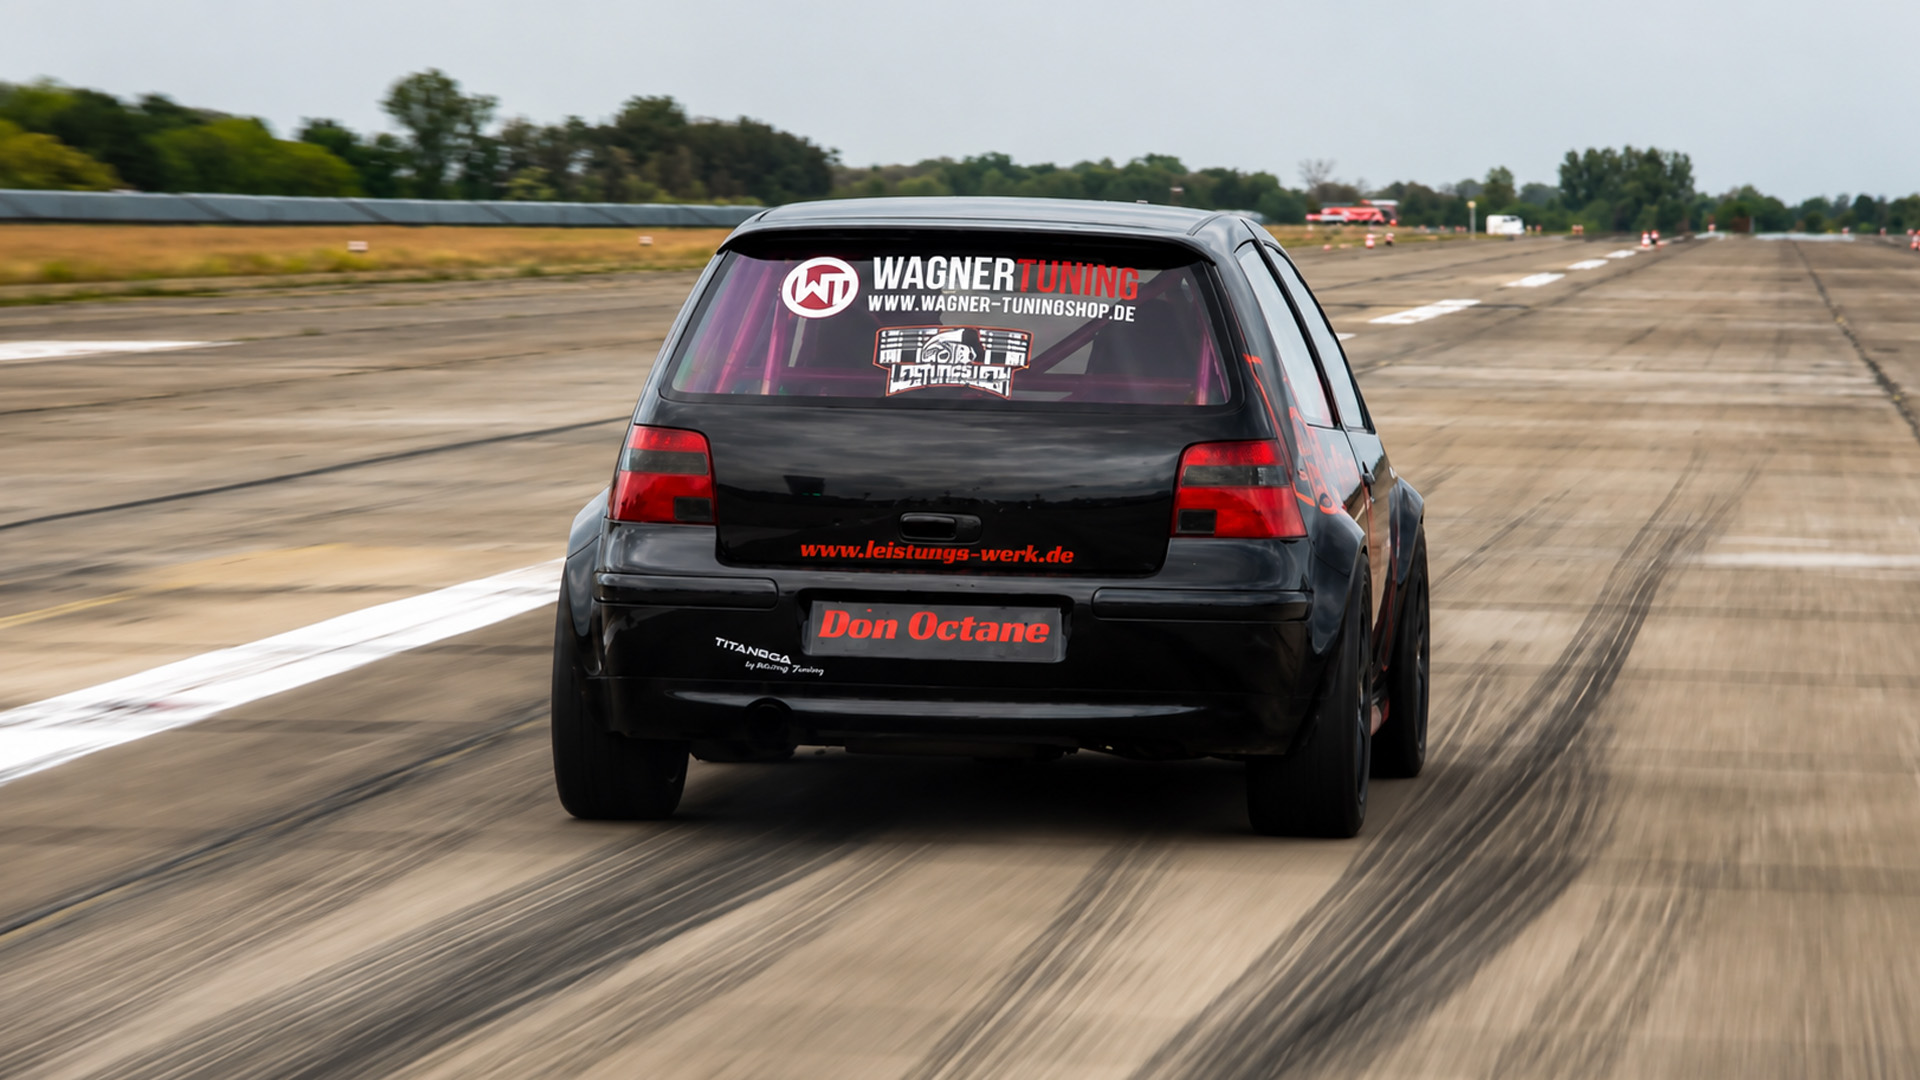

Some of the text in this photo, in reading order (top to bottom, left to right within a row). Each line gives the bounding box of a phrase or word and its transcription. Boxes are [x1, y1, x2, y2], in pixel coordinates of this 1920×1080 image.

[790, 264, 850, 308] WT
[868, 294, 1135, 322] WWW.WAGNER-TUNINGSHOP.DE
[800, 540, 1074, 564] www.leistungs-werk.de
[818, 609, 1050, 643] Don Octane
